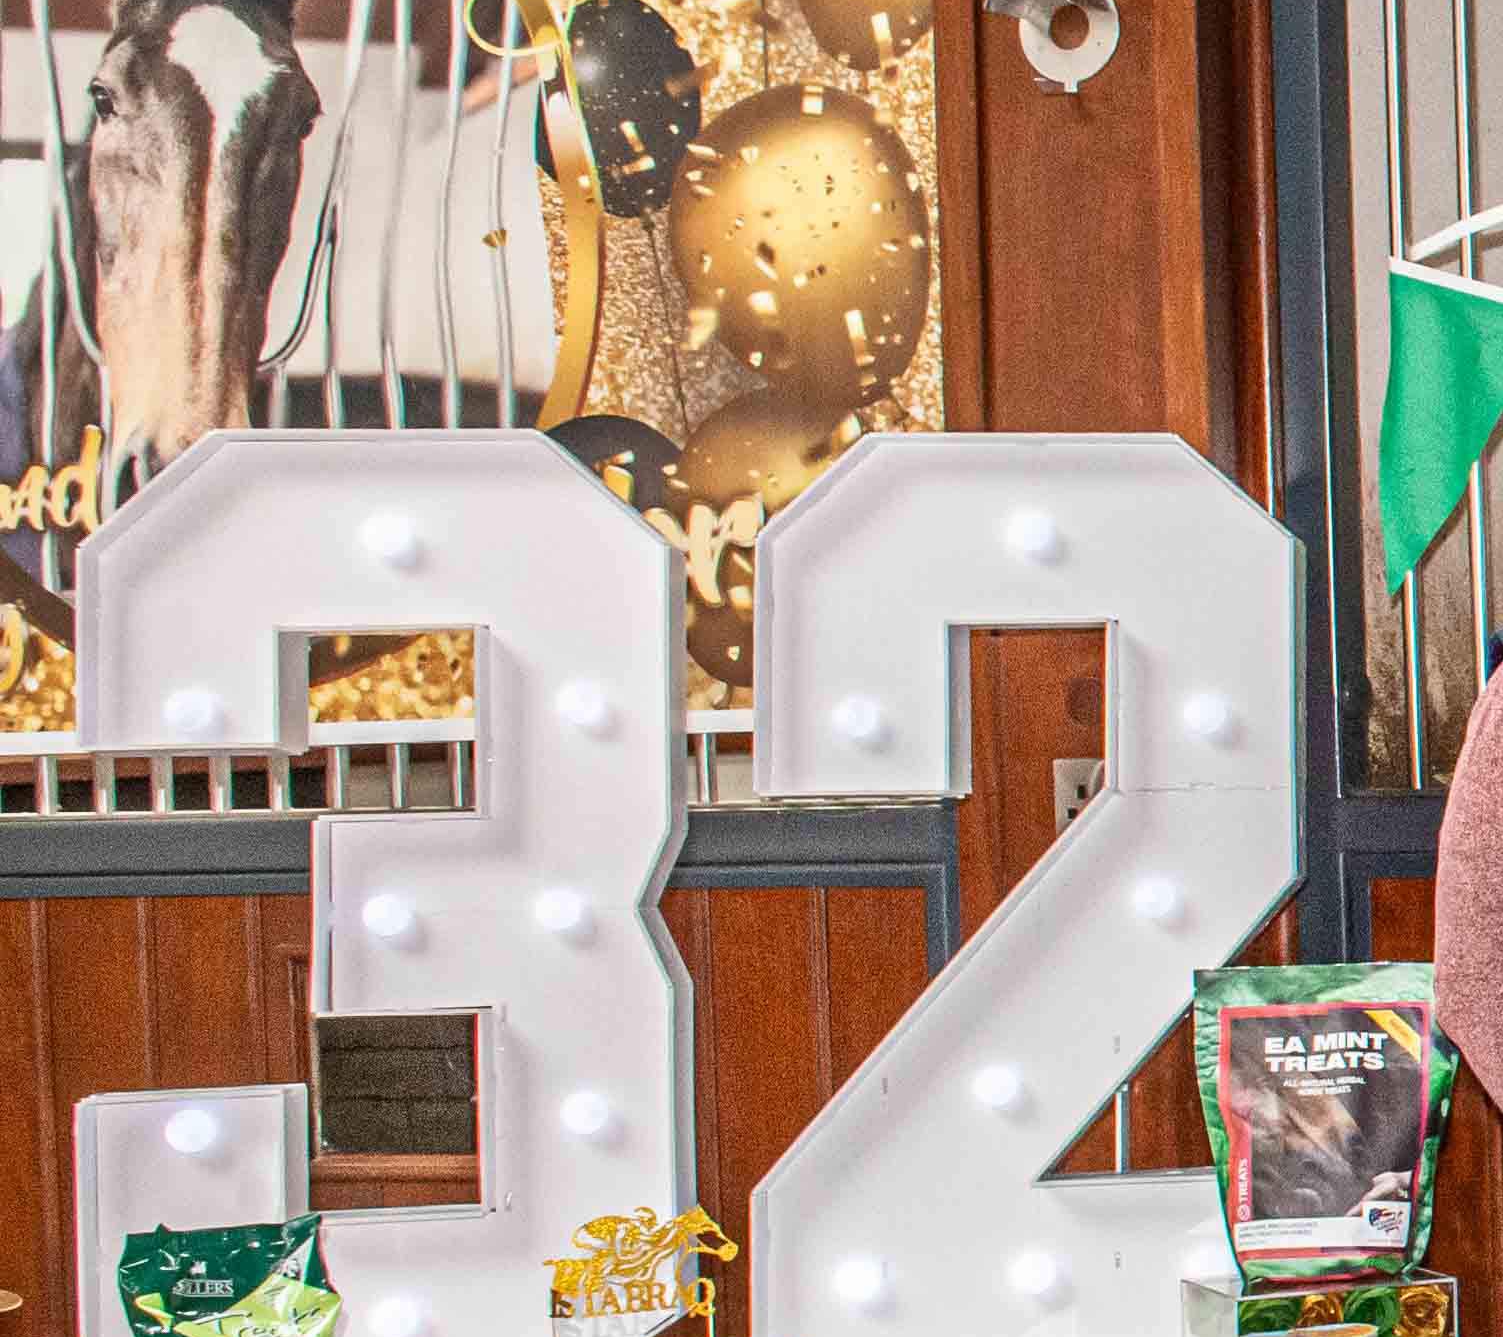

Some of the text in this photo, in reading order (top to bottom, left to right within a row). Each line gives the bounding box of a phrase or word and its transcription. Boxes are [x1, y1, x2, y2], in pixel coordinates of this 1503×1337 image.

[1264, 1036, 1306, 1055] EA
[1313, 1032, 1388, 1052] MINT
[1264, 1051, 1386, 1073] TREATS
